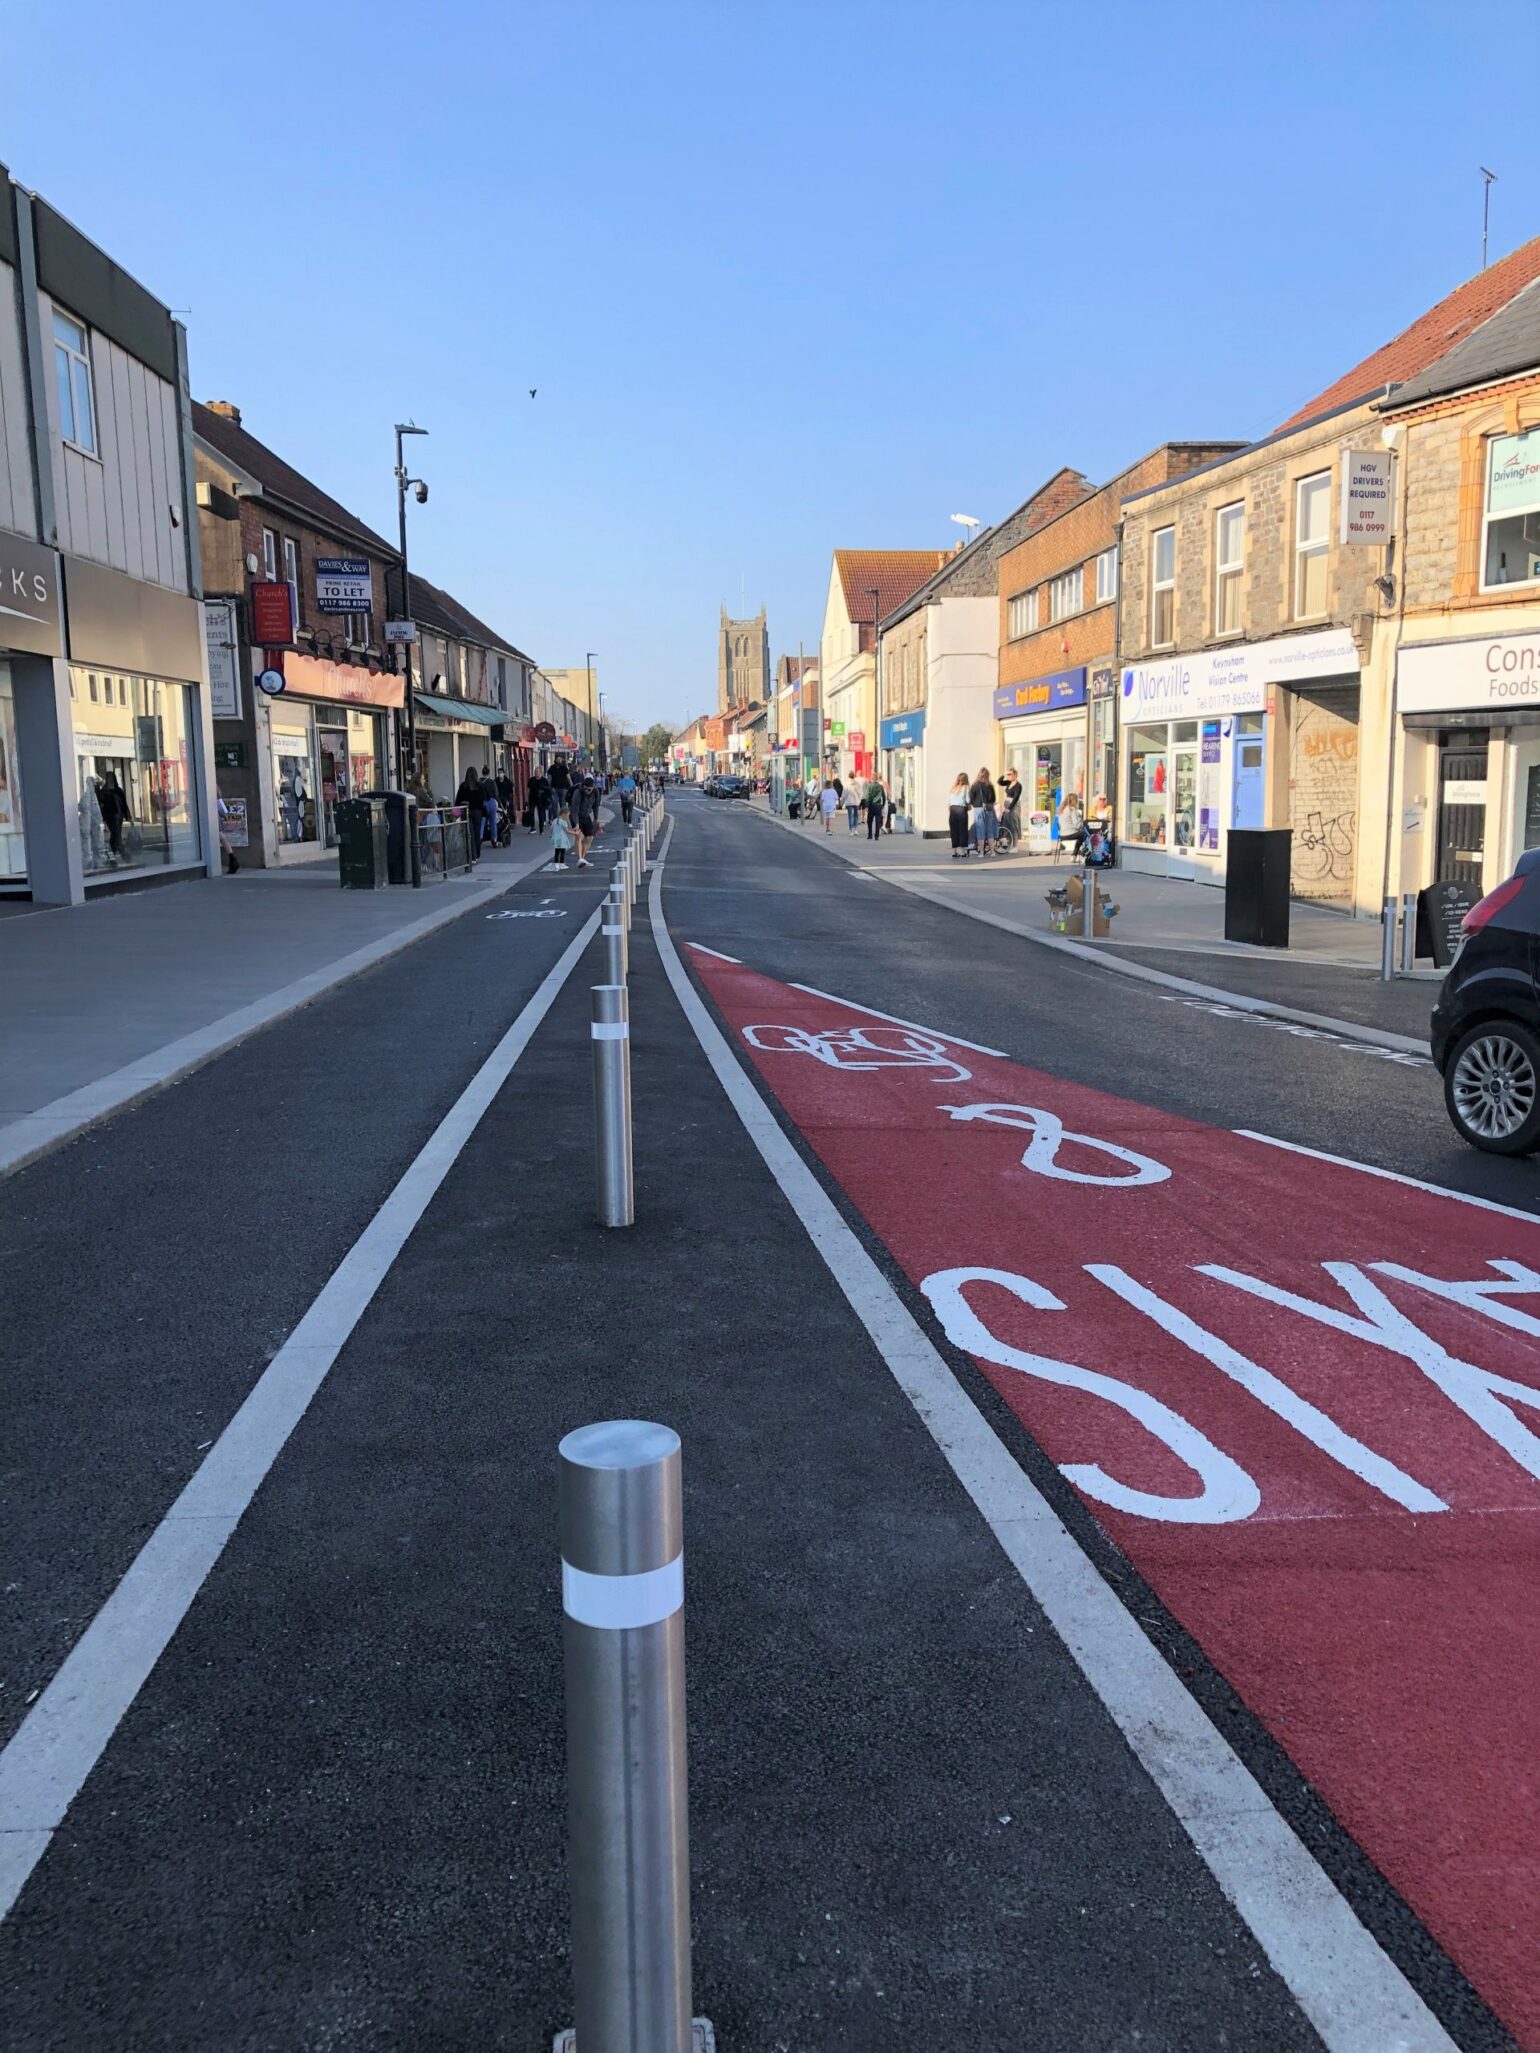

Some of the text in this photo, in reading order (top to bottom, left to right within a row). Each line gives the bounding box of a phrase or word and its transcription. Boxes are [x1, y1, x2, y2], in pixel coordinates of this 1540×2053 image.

[1360, 464, 1377, 473] HGV
[1353, 477, 1384, 486] DRIVERS
[1349, 490, 1386, 498] REQUIRED
[1359, 511, 1375, 519] 0117
[1349, 523, 1385, 532] 986 0999
[318, 560, 367, 573] DAVIES & WAY
[0, 567, 48, 602] KS
[255, 588, 288, 598] Church's
[323, 587, 365, 597] TO LET
[1213, 656, 1245, 670] Keynsham
[1486, 644, 1540, 673] Con
[328, 666, 372, 699] Church's
[1140, 665, 1190, 700] Norville
[1208, 672, 1249, 687] Vision Centre
[1489, 674, 1538, 698] Foods
[1233, 692, 1261, 706] 865066
[1143, 704, 1184, 716] OPTICIANS
[1158, 996, 1342, 1039] LOADING
